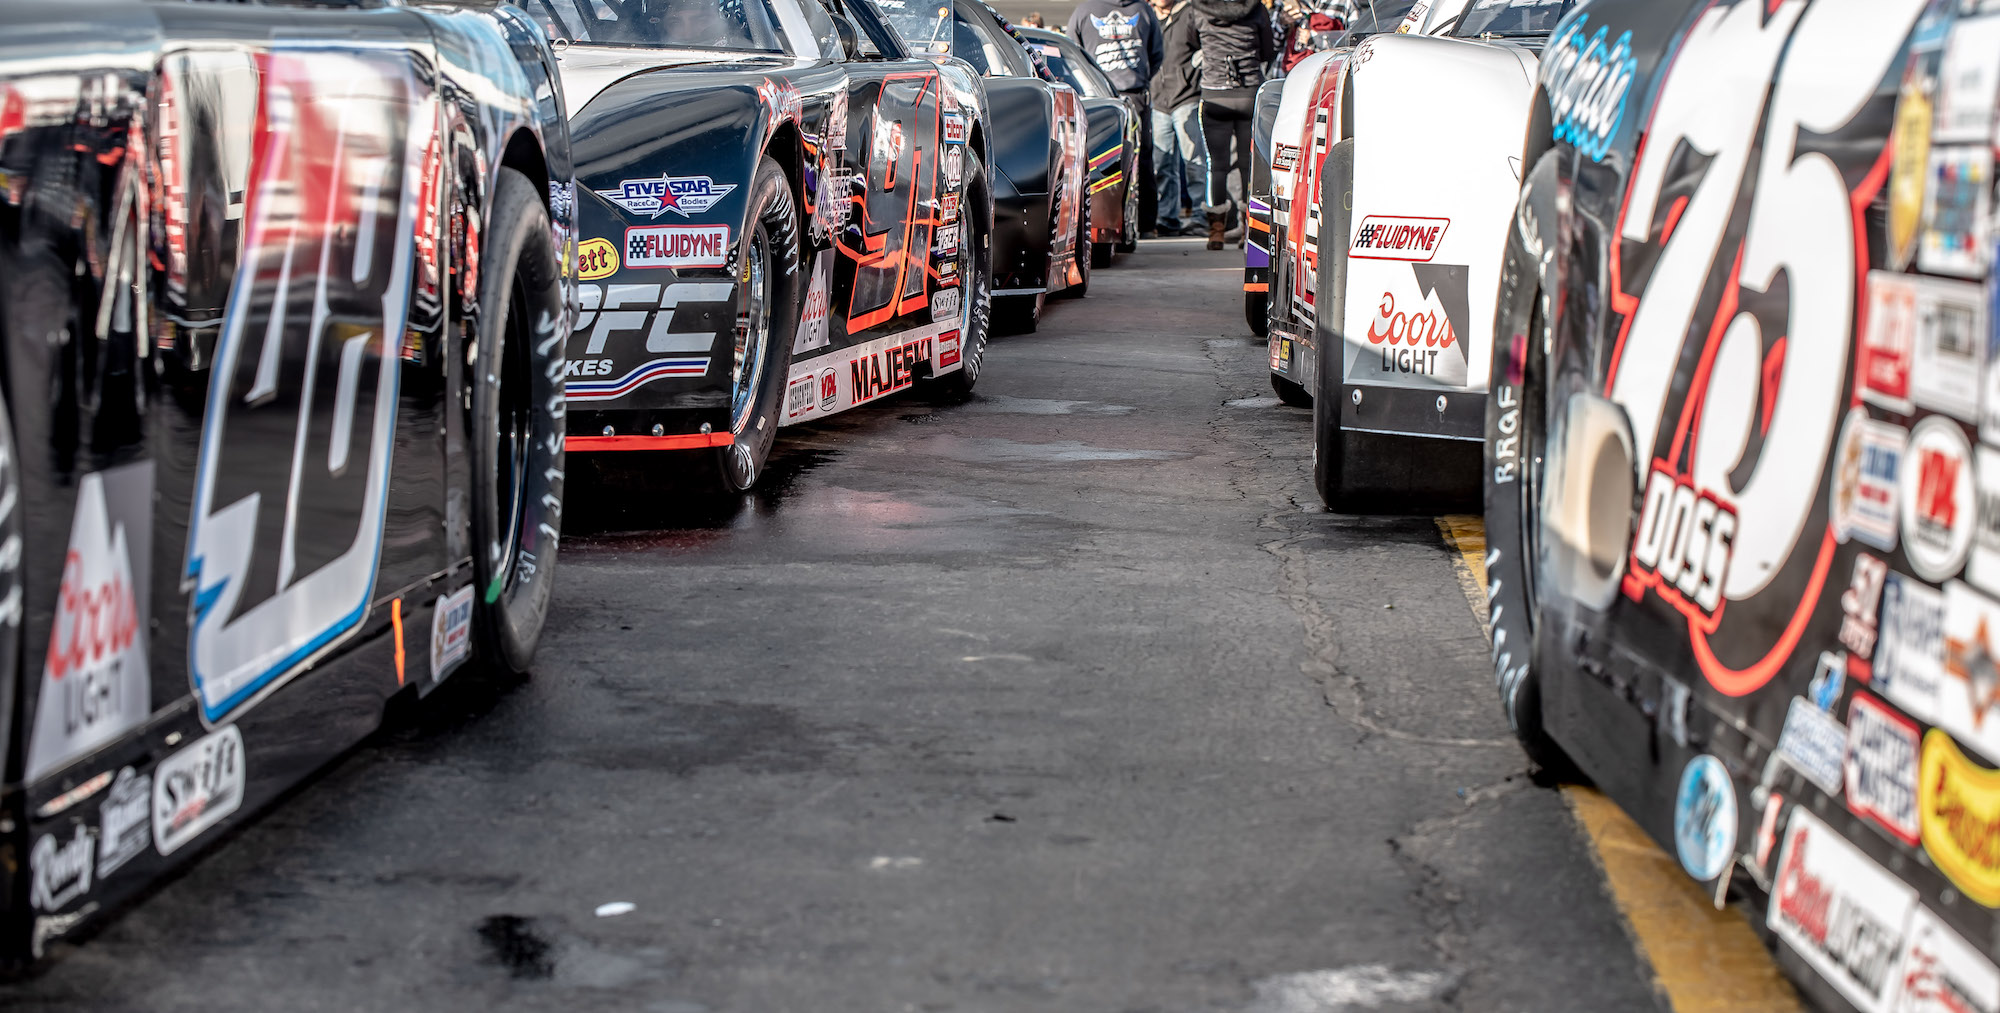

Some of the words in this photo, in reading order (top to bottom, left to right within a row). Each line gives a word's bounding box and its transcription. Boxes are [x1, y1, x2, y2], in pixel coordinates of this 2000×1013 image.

[624, 182, 664, 199] FIVE
[669, 180, 710, 195] STAR
[627, 200, 660, 208] RaceCar
[681, 198, 708, 206] Bodies
[848, 72, 941, 335] 91
[645, 233, 723, 259] FLUIDYNE
[1368, 224, 1441, 251] FLUIDYNE
[933, 291, 958, 312] Swift
[802, 319, 822, 345] LIGHT
[1367, 291, 1457, 349] Coors
[565, 359, 614, 376] KES
[1382, 347, 1439, 376] LIGHT
[1633, 468, 1737, 613] DOSS
[63, 658, 124, 737] LIGHT
[161, 734, 238, 819] Swift
